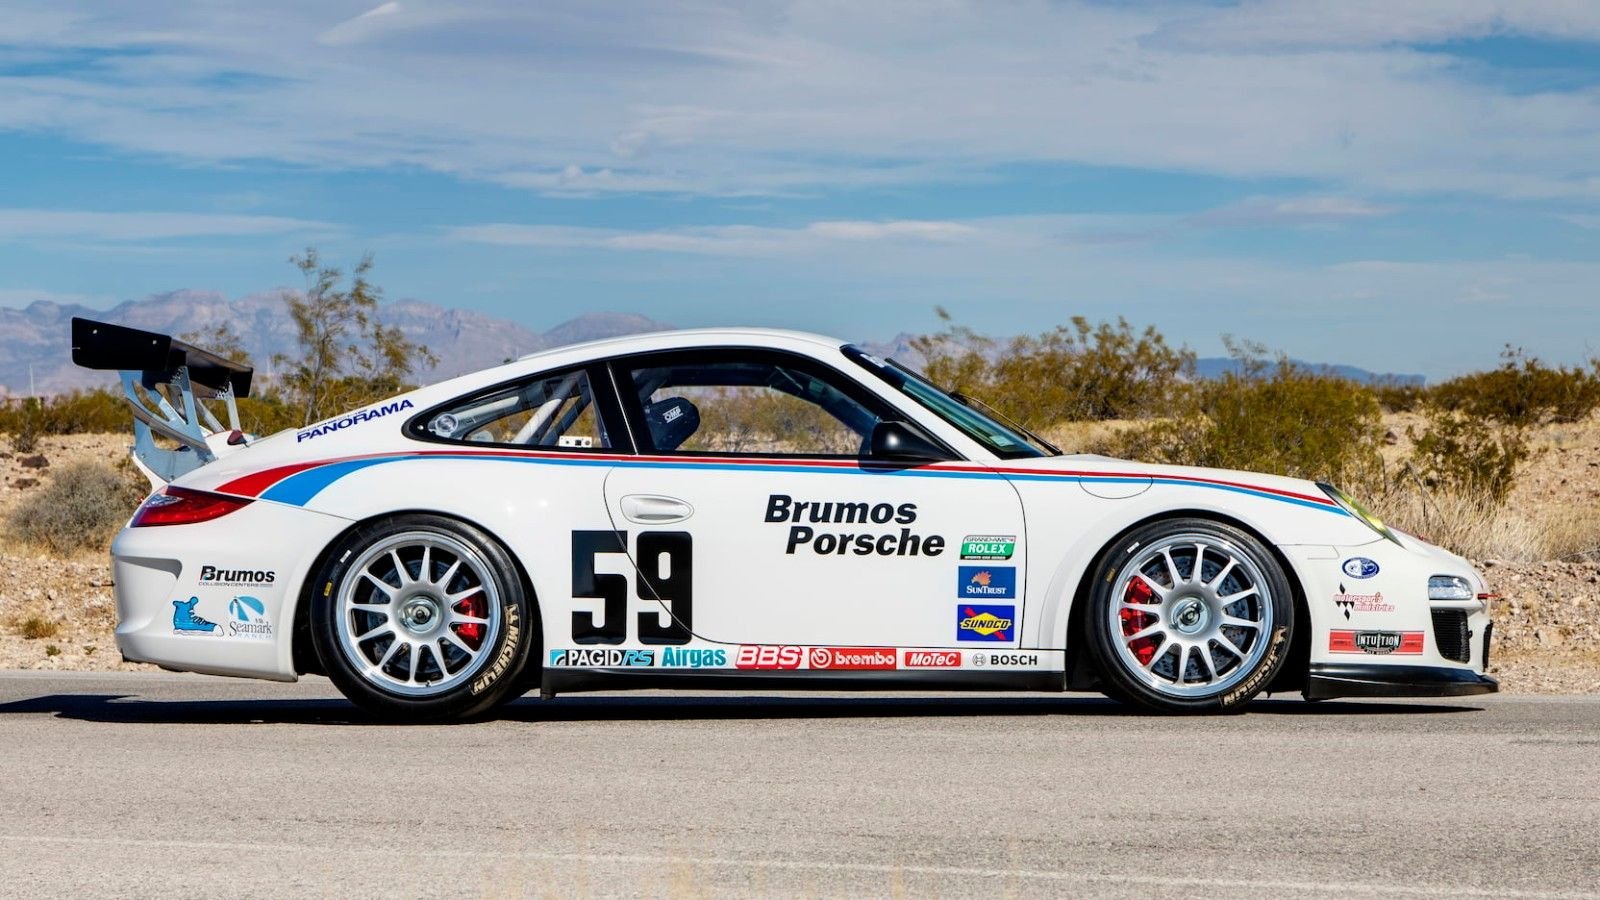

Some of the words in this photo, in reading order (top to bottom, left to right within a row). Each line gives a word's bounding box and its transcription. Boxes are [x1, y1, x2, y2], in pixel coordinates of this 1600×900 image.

[297, 400, 414, 442] PANORAMA
[664, 407, 682, 421] OMP
[764, 494, 918, 524] Brumos
[786, 526, 945, 556] Porsche
[968, 543, 1007, 554] ROLEX
[199, 565, 275, 583] Brumos
[571, 530, 693, 645] 59
[229, 620, 272, 637] Seamark
[962, 619, 1009, 629] SUNOCO
[1357, 633, 1400, 648] INTUITION
[473, 625, 519, 693] MICHELIN
[568, 650, 622, 667] PAGID
[621, 650, 654, 667] RS
[661, 647, 727, 668] Airgas
[736, 645, 801, 667] BBS
[835, 652, 894, 665] brembo
[909, 653, 957, 666] MoTeC
[990, 655, 1038, 666] BOSCH
